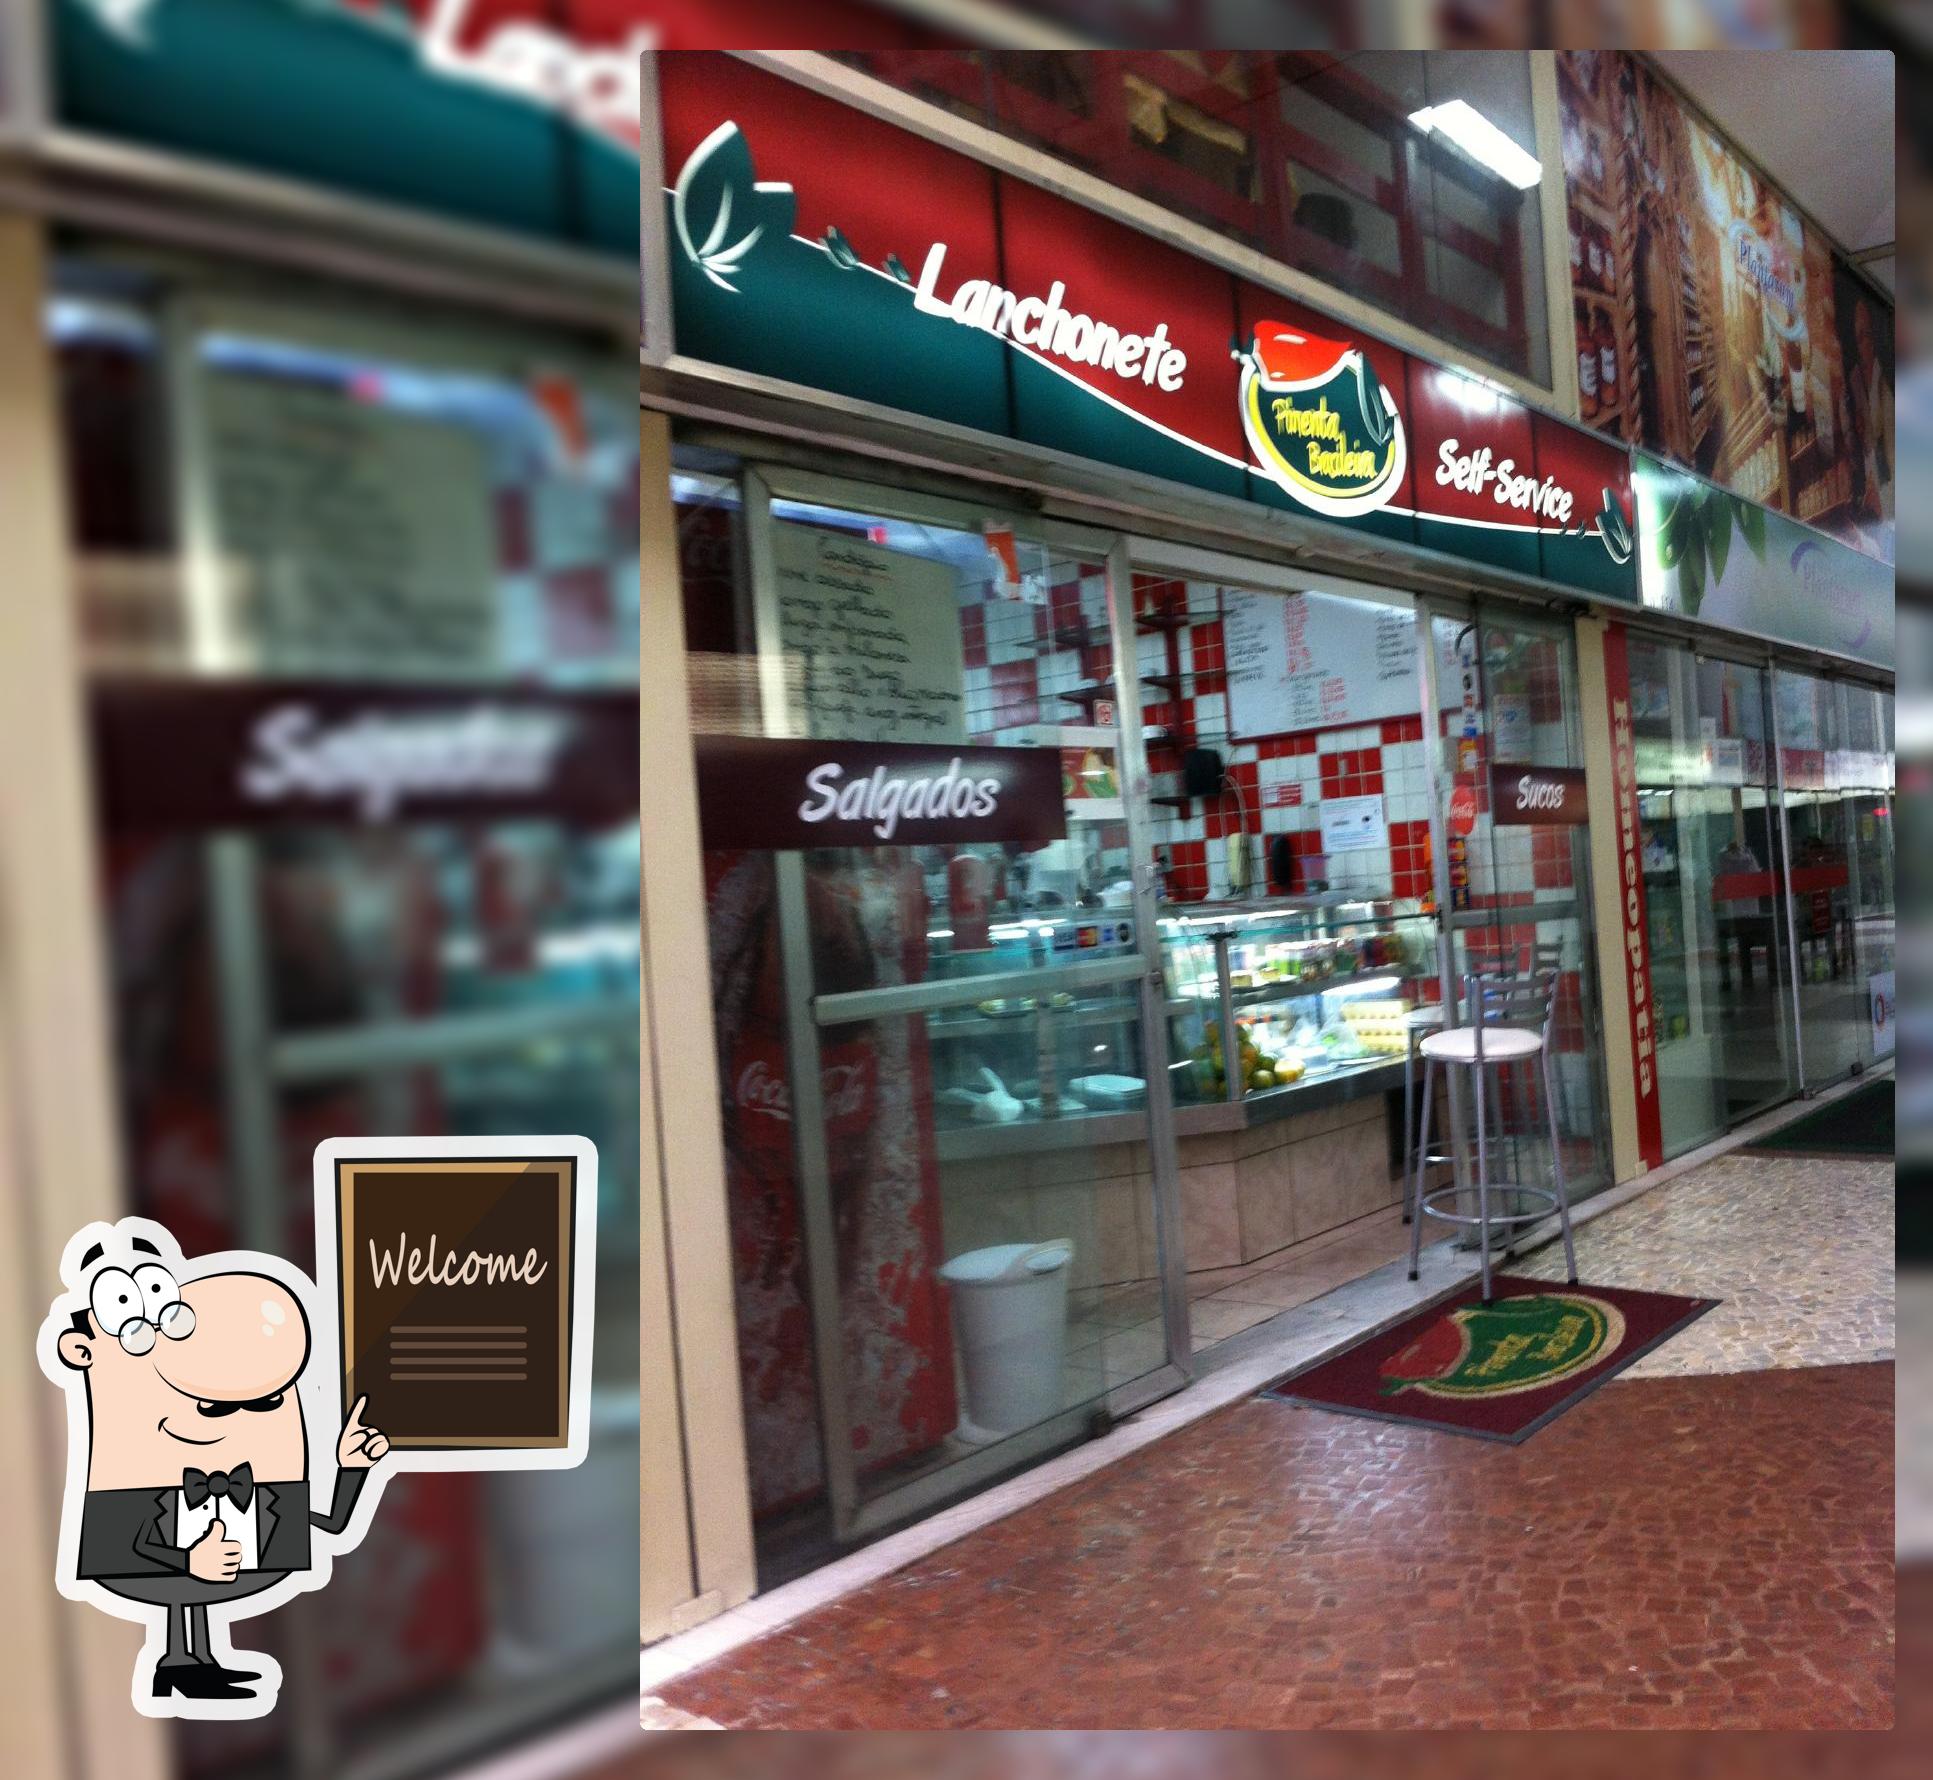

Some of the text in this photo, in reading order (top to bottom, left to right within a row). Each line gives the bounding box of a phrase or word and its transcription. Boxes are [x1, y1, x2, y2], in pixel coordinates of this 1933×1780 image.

[914, 243, 1187, 392] Lanchonete
[1272, 396, 1343, 441] Pimenta
[1435, 438, 1574, 523] Self-Service
[798, 757, 1001, 840] Salgados
[1516, 774, 1566, 811] Sucos
[1613, 697, 1653, 1100] Homeopatia
